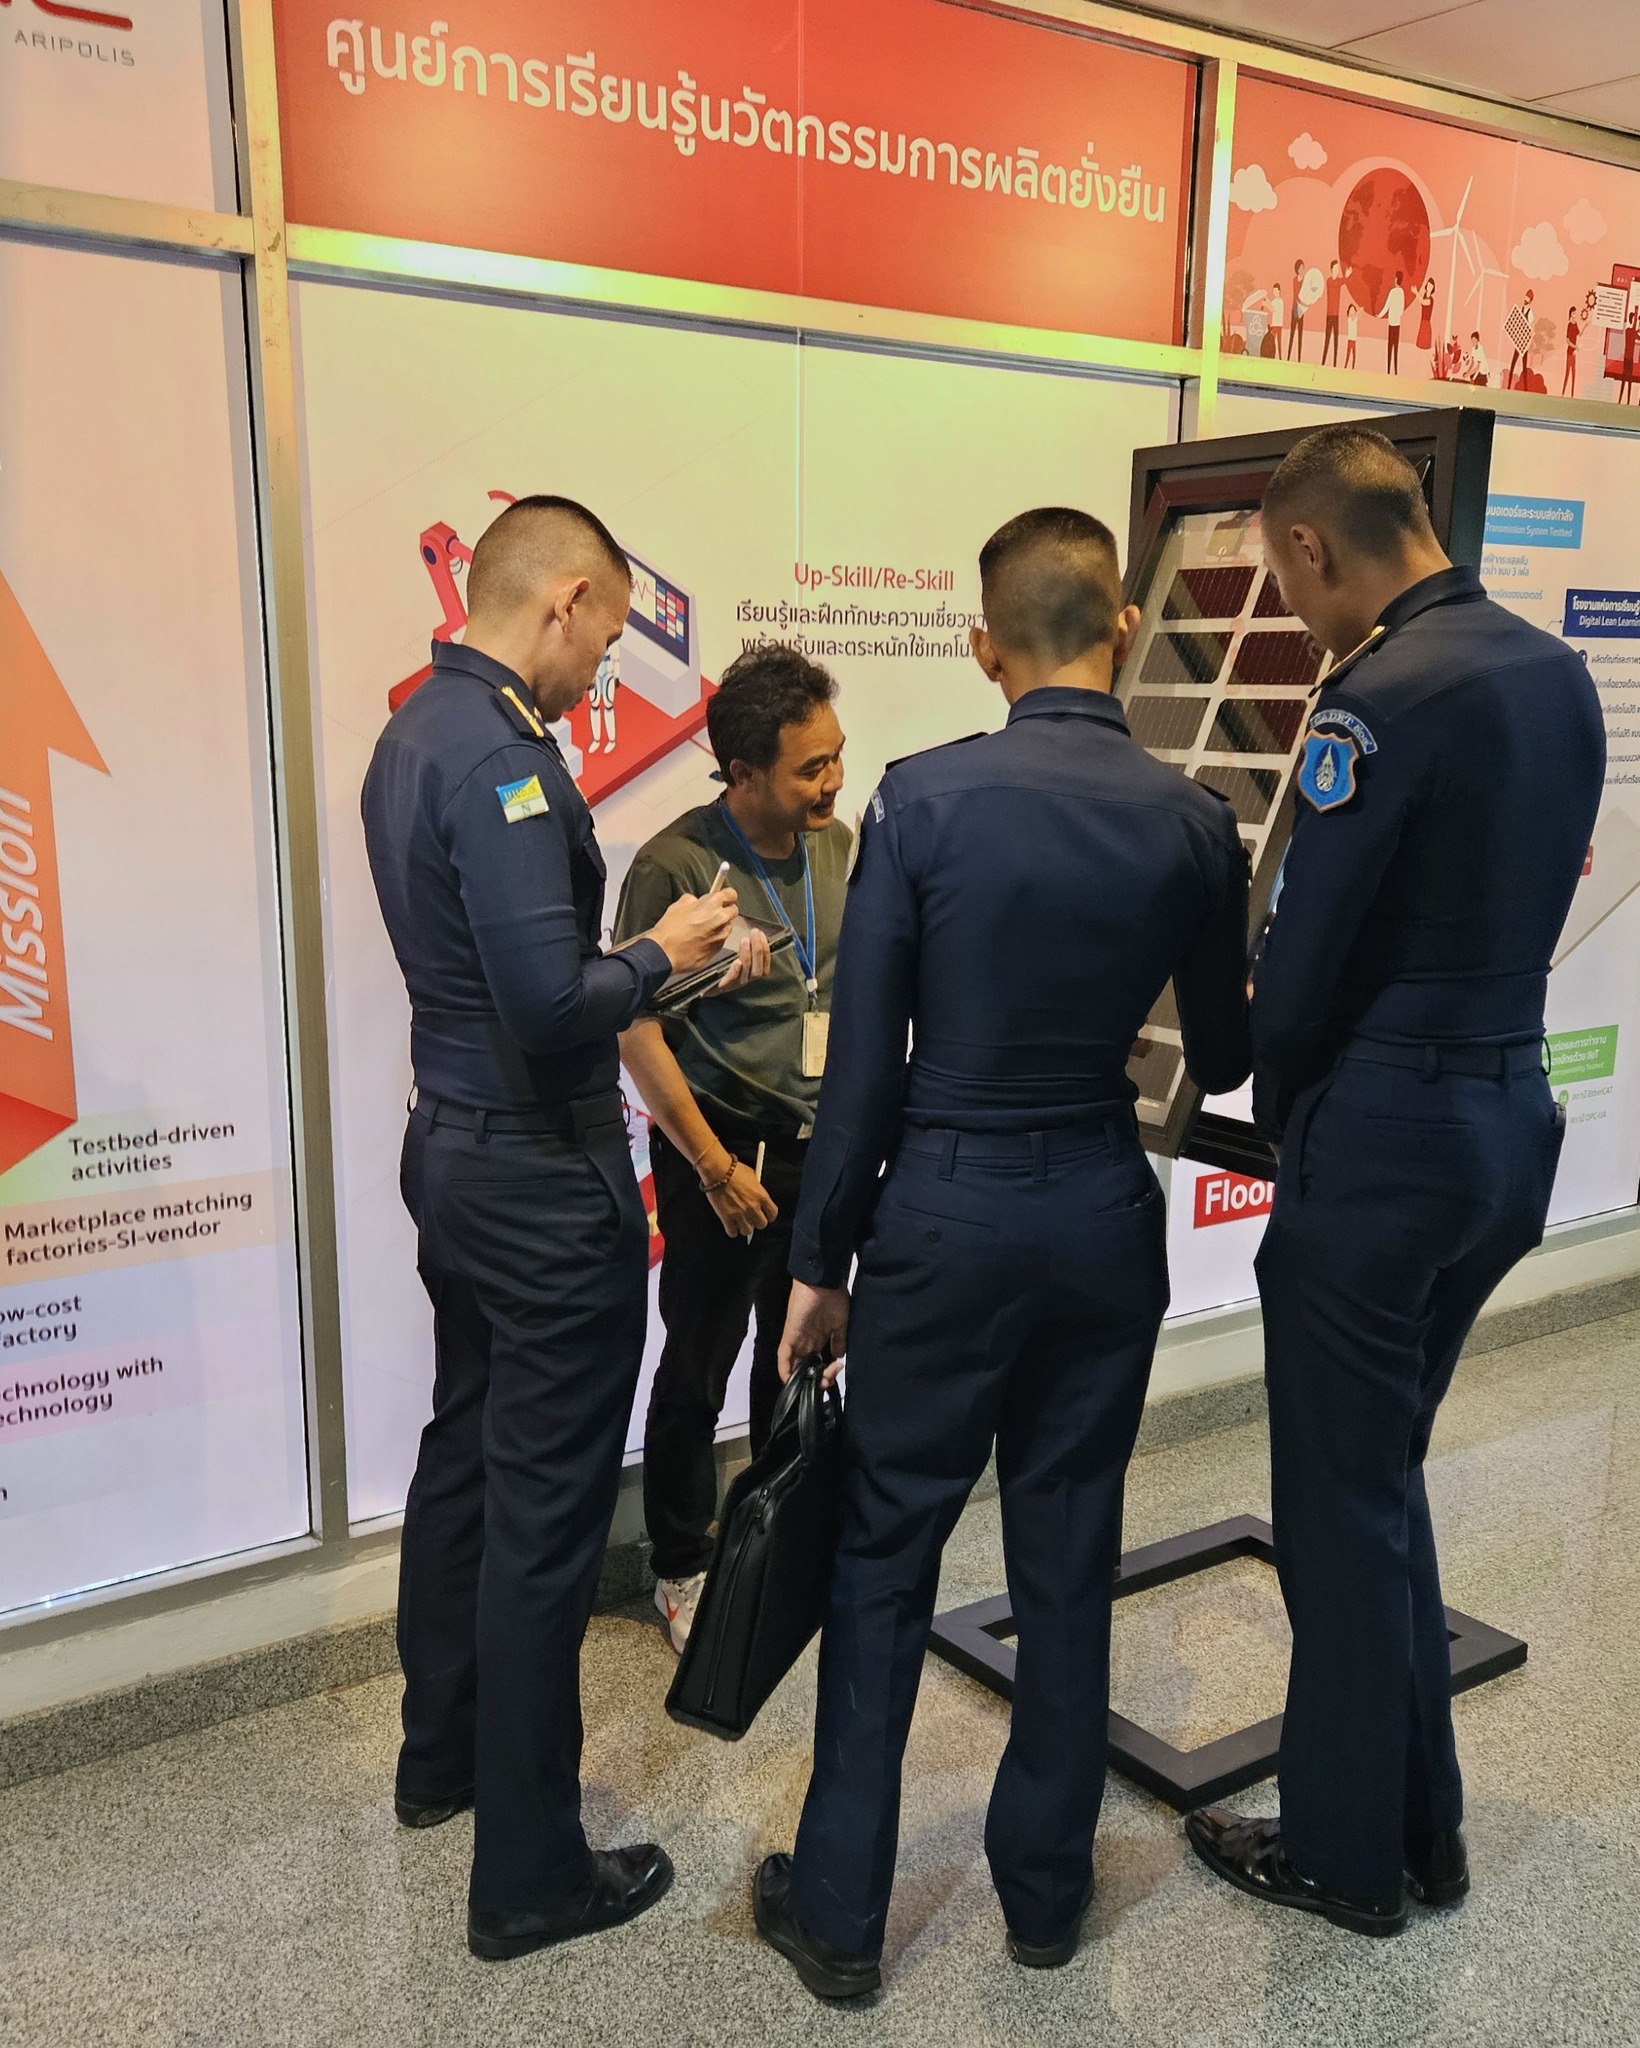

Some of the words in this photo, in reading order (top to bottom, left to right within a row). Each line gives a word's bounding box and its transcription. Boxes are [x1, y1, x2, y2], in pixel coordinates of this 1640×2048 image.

[14, 29, 135, 67] ARIPOLIS
[326, 18, 1166, 223] ศูนย์การเรียนรู้นวัตกรรมการผลิตยั่งยืน
[793, 562, 954, 592] Up-Skill/Re-Skill
[1579, 615, 1601, 628] Digital
[1601, 616, 1618, 627] Lean
[0, 786, 54, 1042] Mission
[68, 1122, 235, 1157] Testbed-driven
[71, 1154, 172, 1181] activities
[4, 1210, 146, 1242] Marketplace
[152, 1192, 253, 1221] matching
[6, 1219, 221, 1267] factories-SI-vendor
[0, 1322, 77, 1349] actory
[0, 1370, 109, 1403] chnology
[116, 1355, 163, 1380] with
